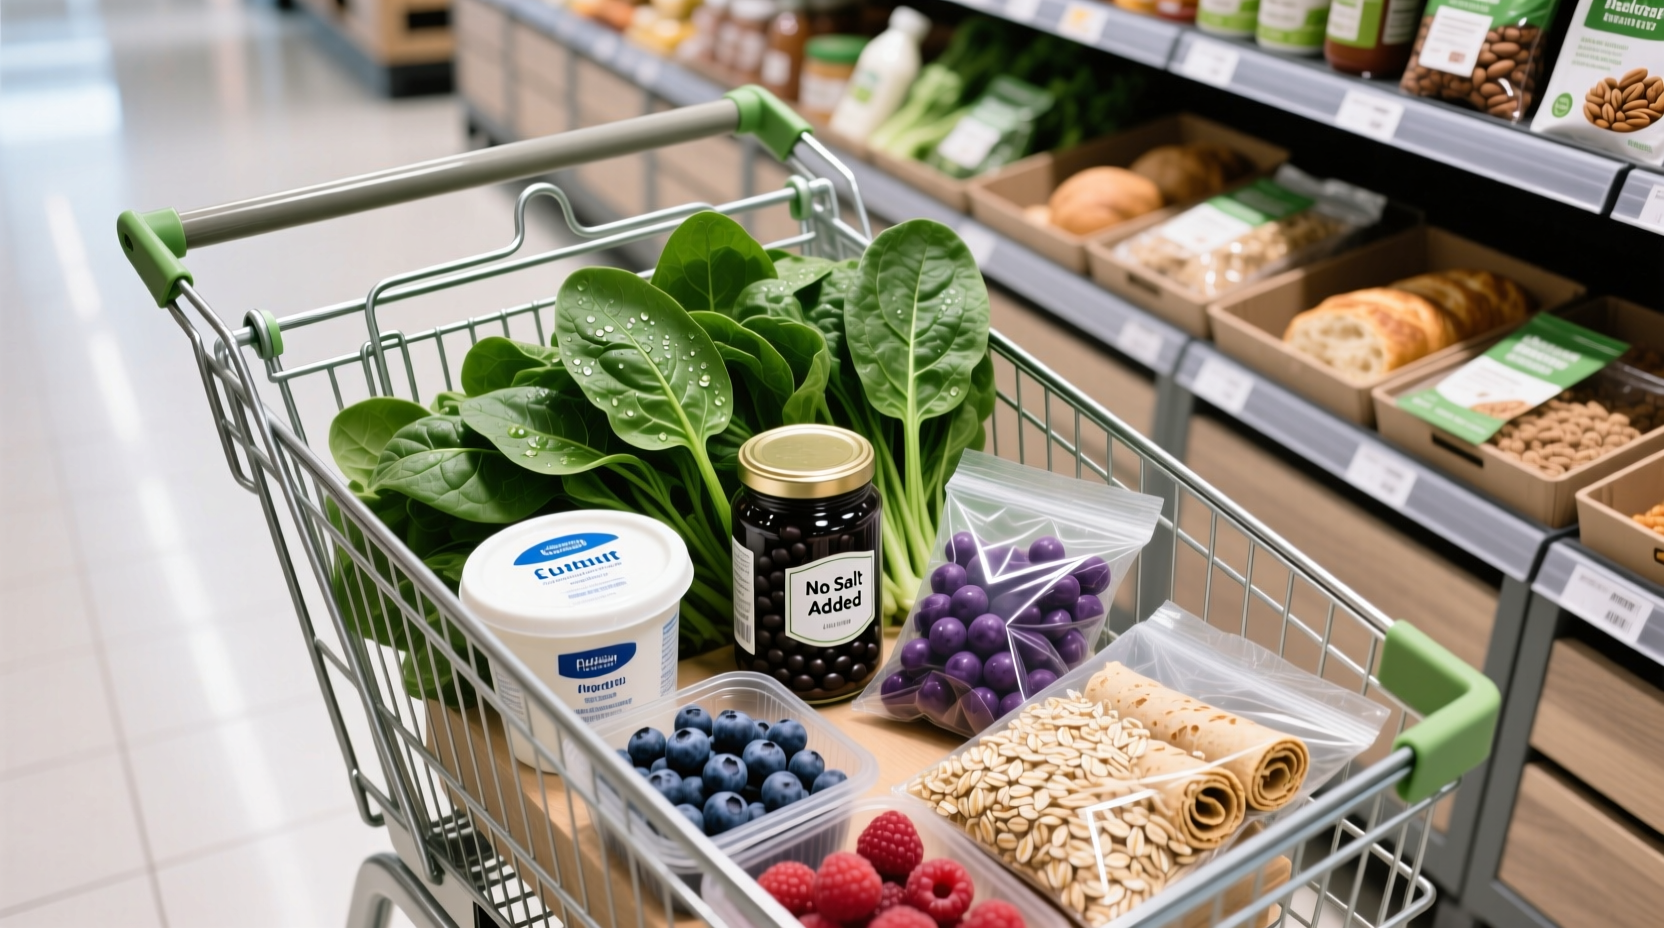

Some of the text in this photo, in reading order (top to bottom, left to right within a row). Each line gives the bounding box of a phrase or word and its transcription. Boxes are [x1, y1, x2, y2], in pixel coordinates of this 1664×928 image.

[806, 570, 863, 596] No Salt
[808, 590, 861, 616] Added
